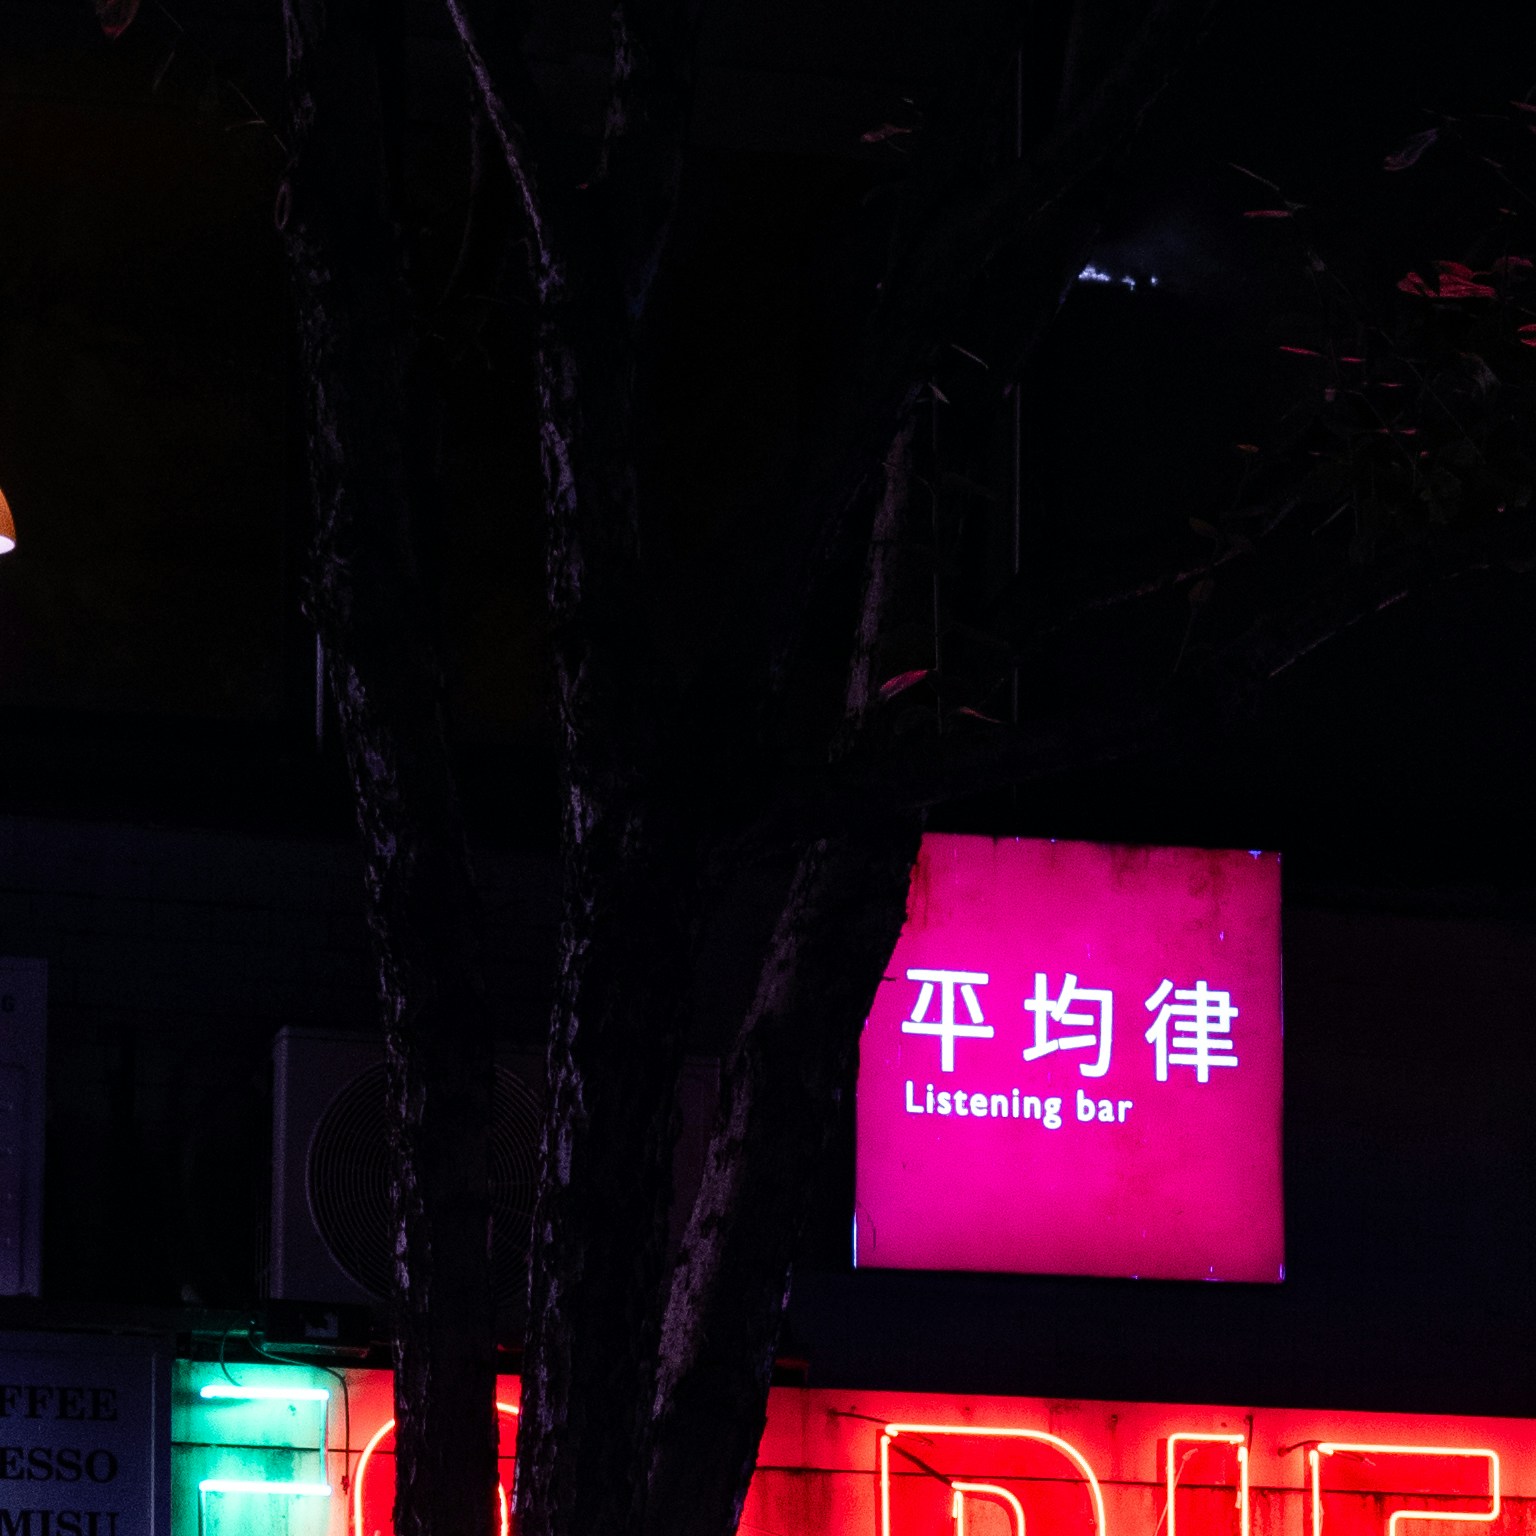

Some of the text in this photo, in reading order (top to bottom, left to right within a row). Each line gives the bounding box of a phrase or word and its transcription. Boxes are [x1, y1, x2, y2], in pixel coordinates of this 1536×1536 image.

[901, 968, 1239, 1084] 平均律
[905, 1080, 1134, 1129] Listening bar
